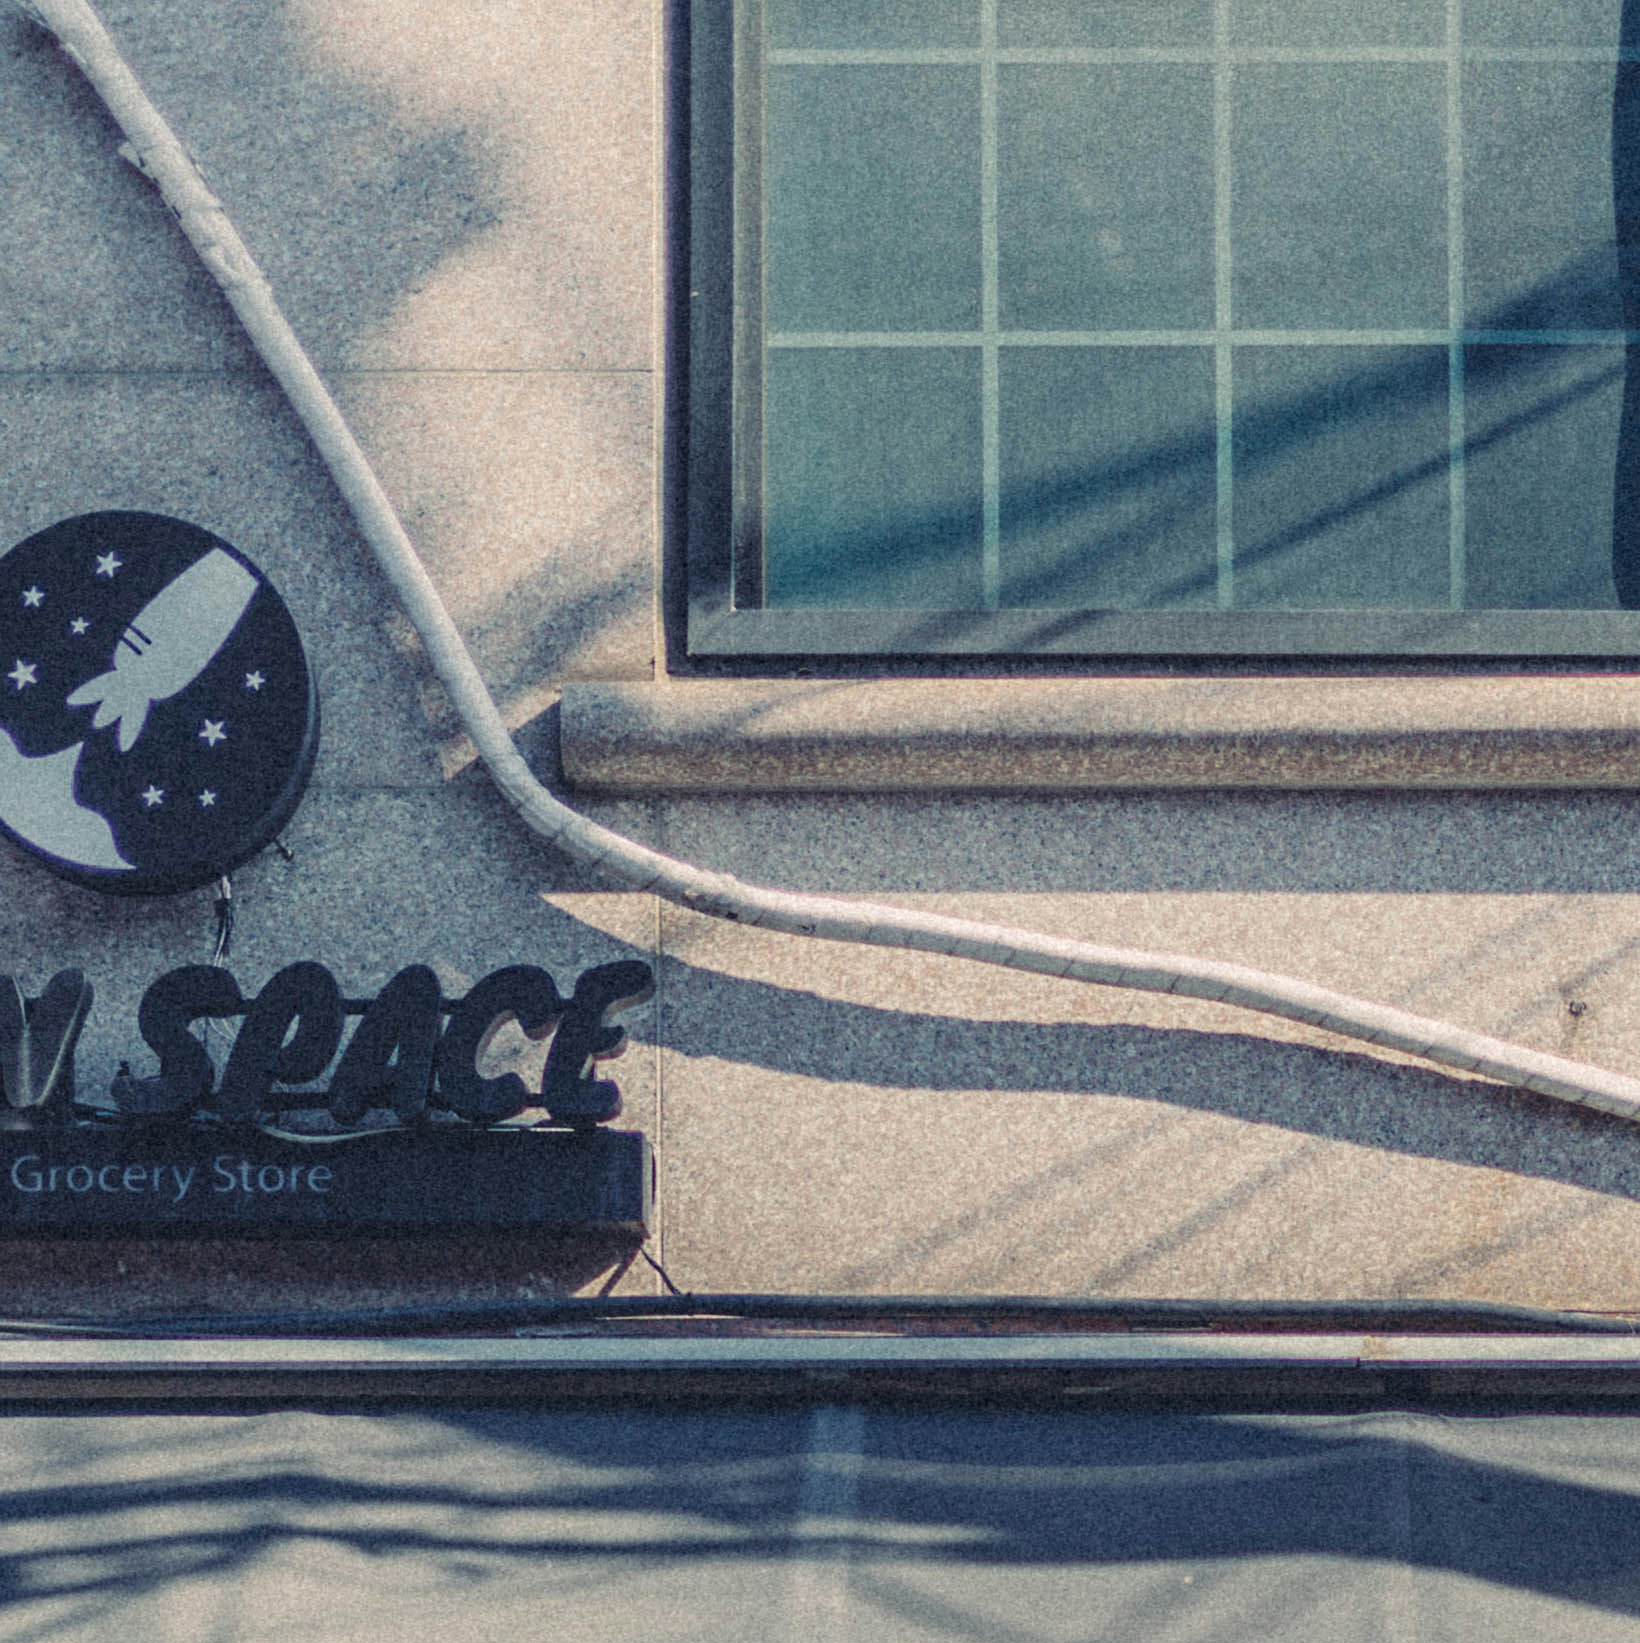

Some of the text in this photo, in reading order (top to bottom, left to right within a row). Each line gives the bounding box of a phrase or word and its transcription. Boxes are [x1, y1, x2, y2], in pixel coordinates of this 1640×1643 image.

[112, 961, 656, 1124] SPACE
[11, 1155, 334, 1200] Grocery Store
